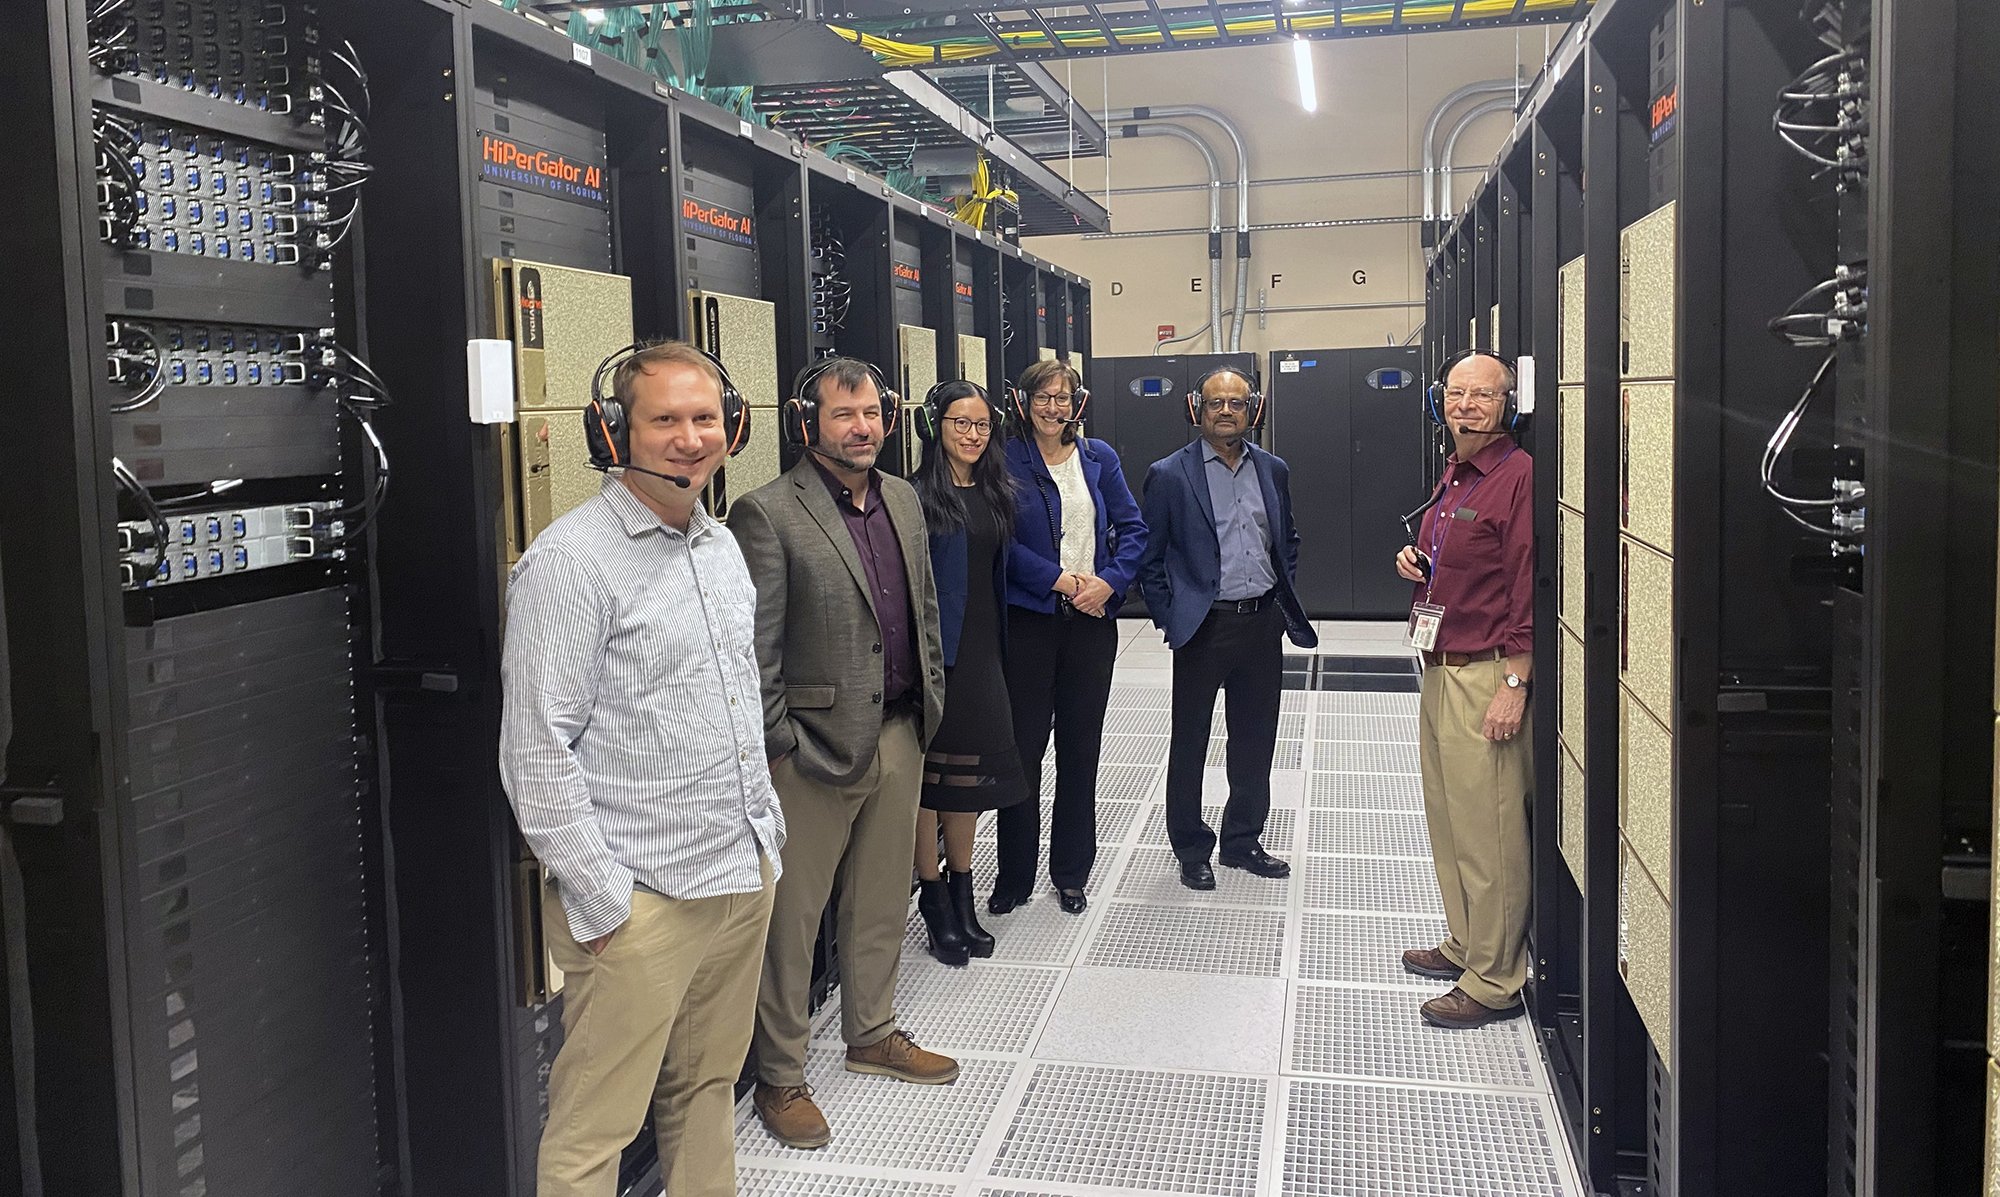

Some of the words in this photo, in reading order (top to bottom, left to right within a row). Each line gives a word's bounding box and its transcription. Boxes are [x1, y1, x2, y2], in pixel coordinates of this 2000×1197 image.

[1652, 84, 1678, 128] HiPer
[483, 136, 581, 183] HiPerGator
[584, 165, 600, 189] AI
[484, 163, 546, 188] UNIVERSITY
[550, 180, 562, 190] OF
[566, 183, 603, 202] FLORIDA
[740, 216, 751, 235] AI
[1191, 278, 1202, 292] E
[1271, 274, 1282, 289] F
[1352, 270, 1366, 285] G
[1111, 281, 1123, 296] D
